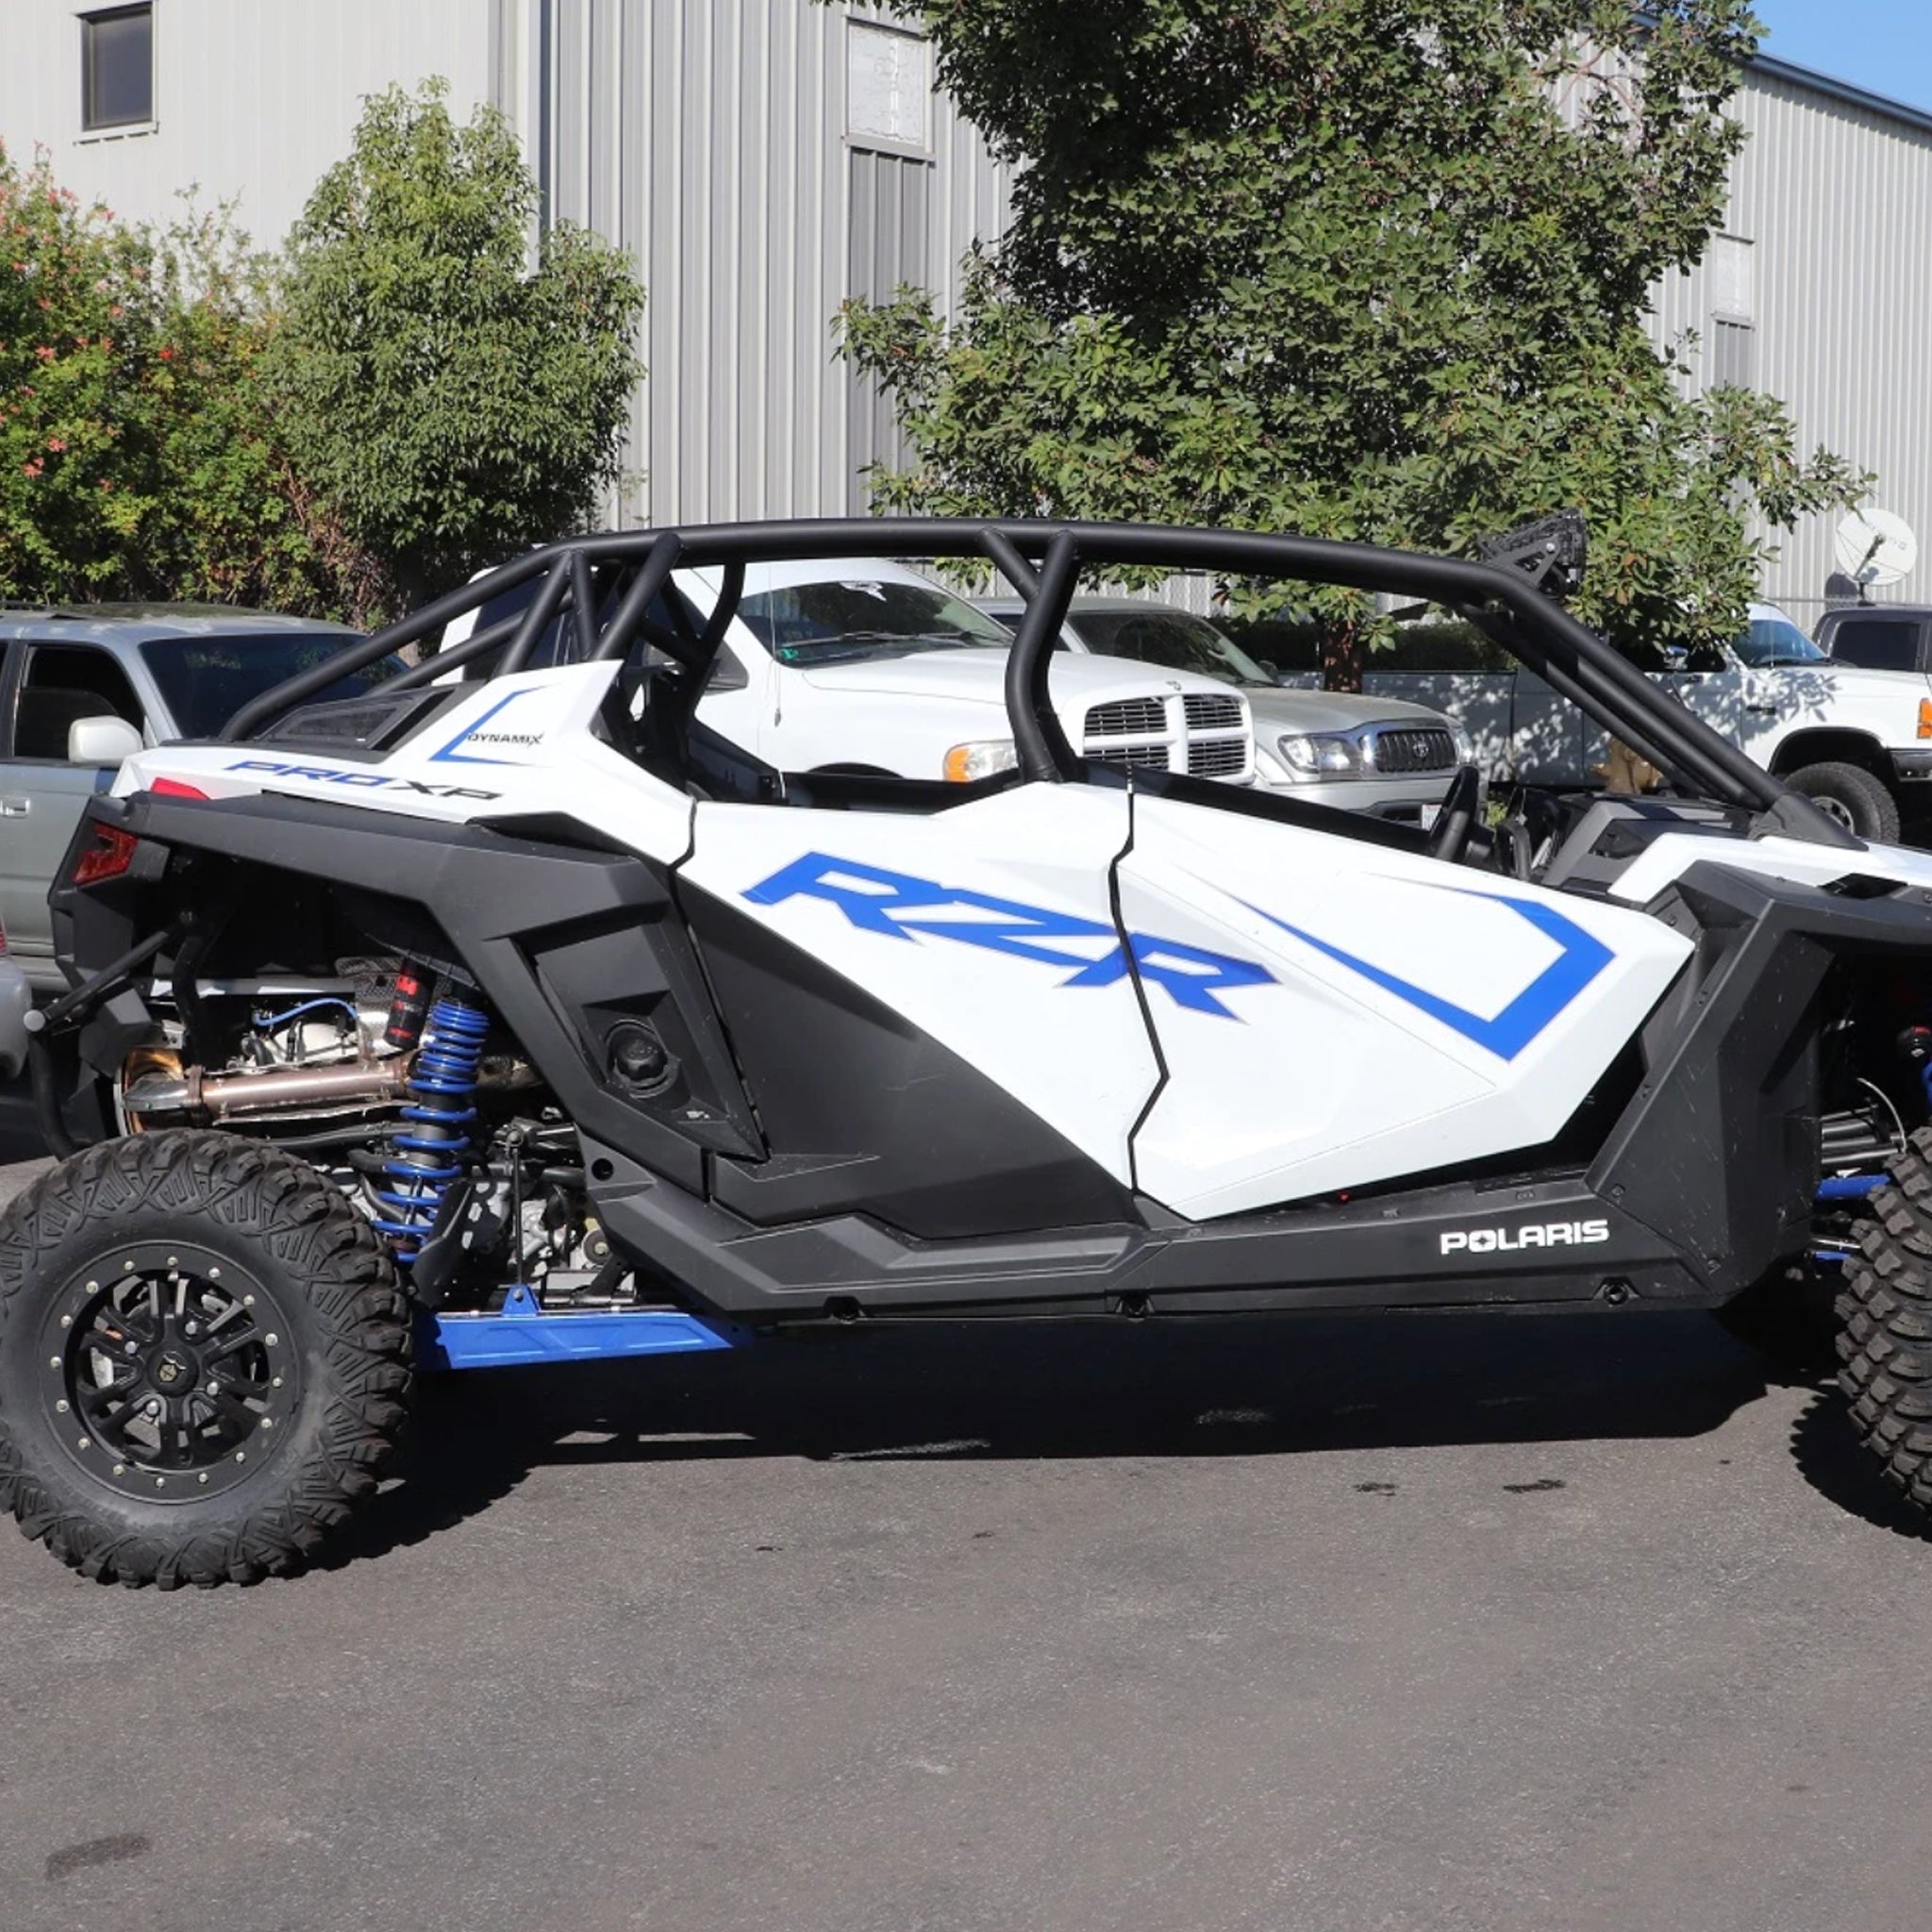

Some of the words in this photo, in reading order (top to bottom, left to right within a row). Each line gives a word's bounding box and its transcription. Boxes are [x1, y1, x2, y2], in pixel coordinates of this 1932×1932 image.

[467, 732, 544, 746] DYNAMIX
[225, 761, 393, 786] PRO
[387, 780, 502, 800] XP
[740, 851, 1284, 1024] RZR
[1440, 1219, 1609, 1255] POLARIS
